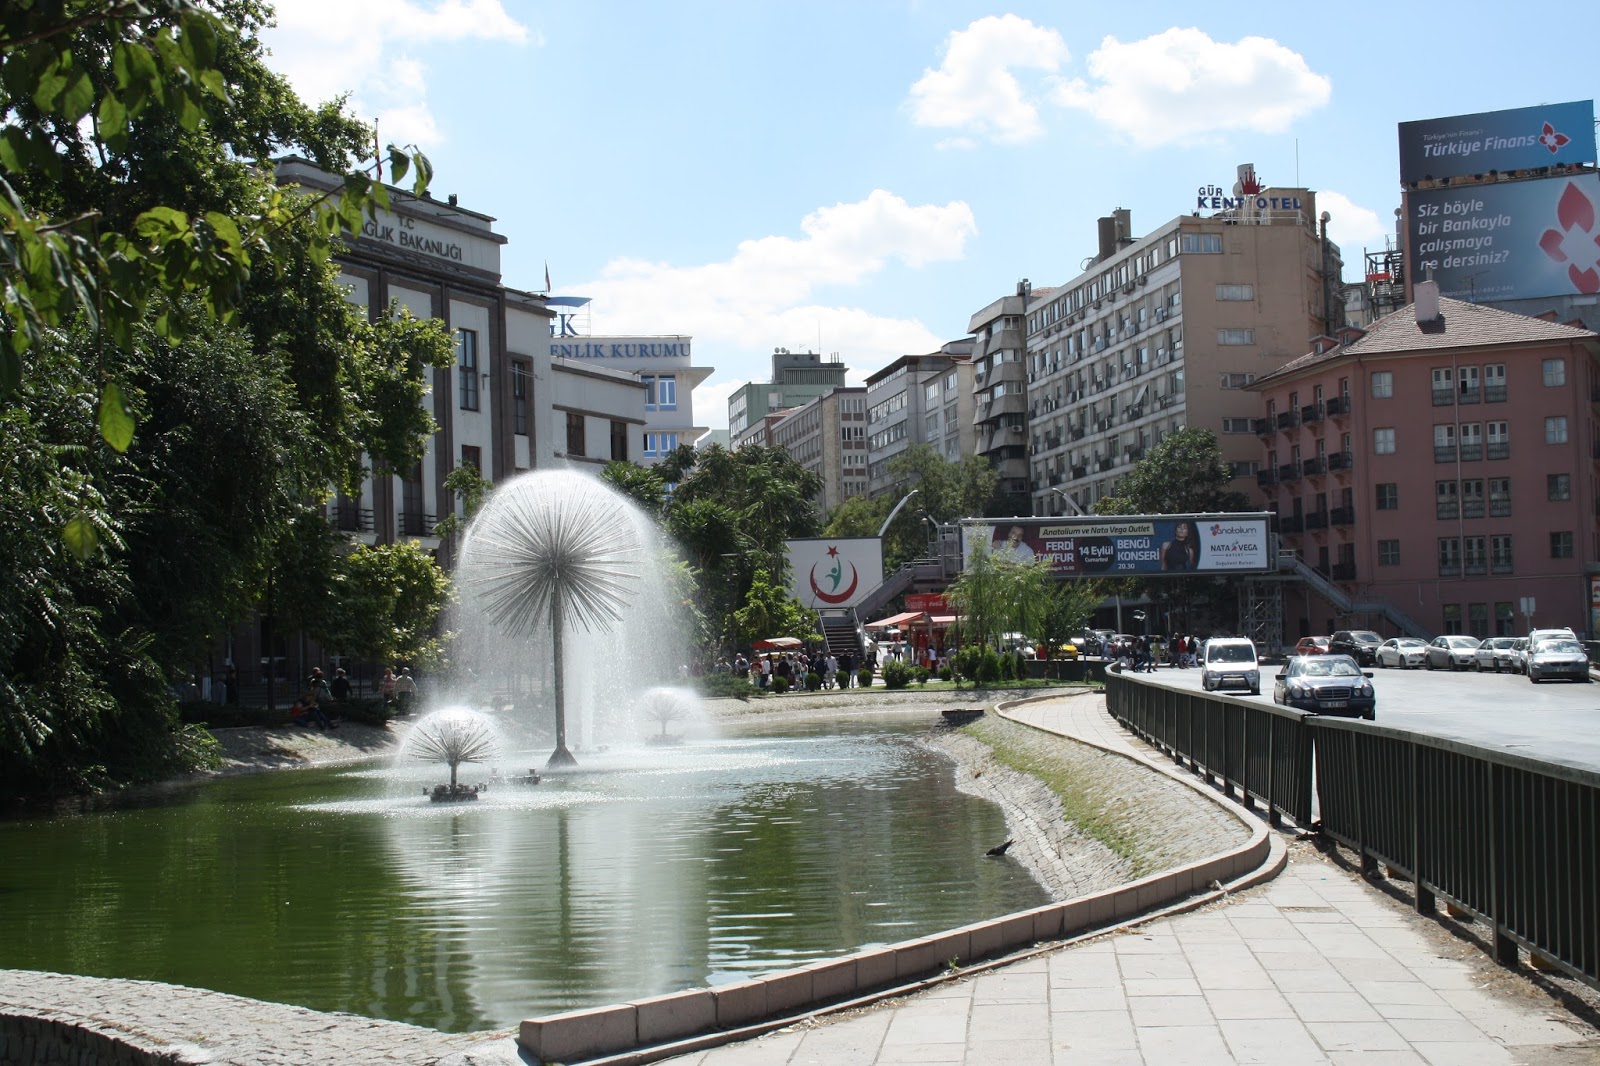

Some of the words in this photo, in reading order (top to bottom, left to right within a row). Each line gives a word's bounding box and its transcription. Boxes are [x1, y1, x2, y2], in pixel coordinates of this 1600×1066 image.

[1423, 140, 1481, 157] Türkiye
[1484, 134, 1536, 151] Finans
[1198, 185, 1223, 196] GÜR
[1198, 197, 1244, 209] KENT
[1256, 198, 1302, 209] OTEL
[1418, 204, 1439, 218] Siz
[1443, 200, 1484, 216] böyle
[1418, 222, 1438, 235] bir
[1442, 214, 1511, 233] Bankayla
[400, 231, 463, 261] BAKANLIĞI
[1419, 236, 1493, 256] çalışmaya
[1420, 259, 1438, 271] ne
[1443, 250, 1509, 269] dersiniz?
[550, 342, 606, 358] ENLİK
[610, 343, 691, 358] KURUMU
[1042, 527, 1081, 536] Anatolium
[1109, 526, 1127, 535] Vega
[1128, 525, 1150, 533] Outlet
[1045, 538, 1074, 551] FERDİ
[1117, 537, 1150, 550] BENGÜ
[1210, 544, 1230, 552] NATA
[1237, 543, 1258, 551] VEGA
[1079, 546, 1089, 556] 14
[1091, 545, 1114, 557] Eylül
[1117, 548, 1160, 561] KONSERİ
[1037, 553, 1075, 563] TAYFUR
